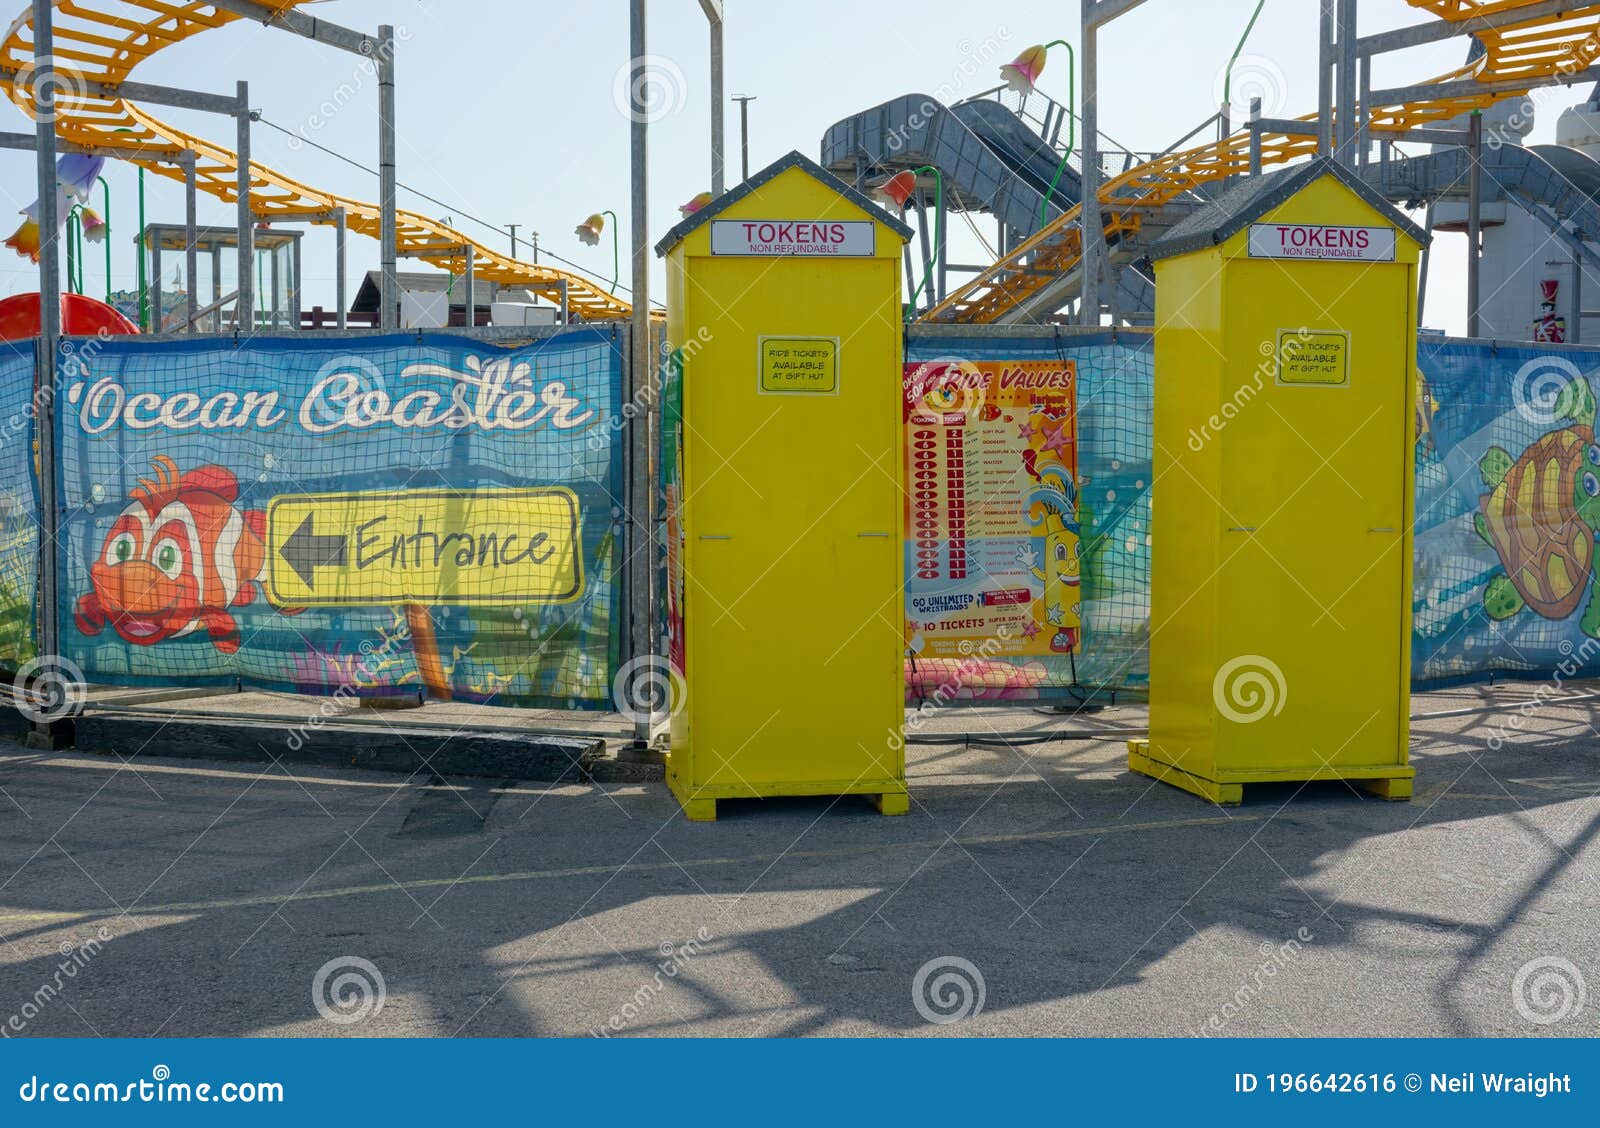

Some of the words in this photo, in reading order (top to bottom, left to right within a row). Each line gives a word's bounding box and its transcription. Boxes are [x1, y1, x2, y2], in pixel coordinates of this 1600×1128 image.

[742, 223, 845, 243] TOKENS
[1276, 227, 1369, 248] TOKENS
[750, 244, 771, 253] NON
[774, 244, 839, 254] REFUNDABLE
[1283, 247, 1303, 256] NON
[1305, 248, 1363, 258] REFUNDABLE
[1308, 343, 1341, 351] TICKETS
[769, 350, 790, 358] RIDE
[793, 350, 829, 358] TICKETS
[1290, 354, 1337, 363] AVAILABLE
[772, 362, 825, 370] AVAILABLE
[1322, 364, 1337, 373] HUT
[786, 372, 806, 380] GIFT
[809, 372, 825, 380] HUT
[902, 363, 928, 390] OKENS
[943, 368, 993, 392] RIDE
[1000, 367, 1072, 390] VALUES
[78, 375, 286, 434] Ocean
[299, 356, 594, 433] Coaster
[356, 514, 556, 569] Entrance
[912, 598, 926, 608] GO
[928, 594, 974, 606] UNLIMITED
[924, 622, 936, 632] 10
[940, 618, 985, 631] TICKETS
